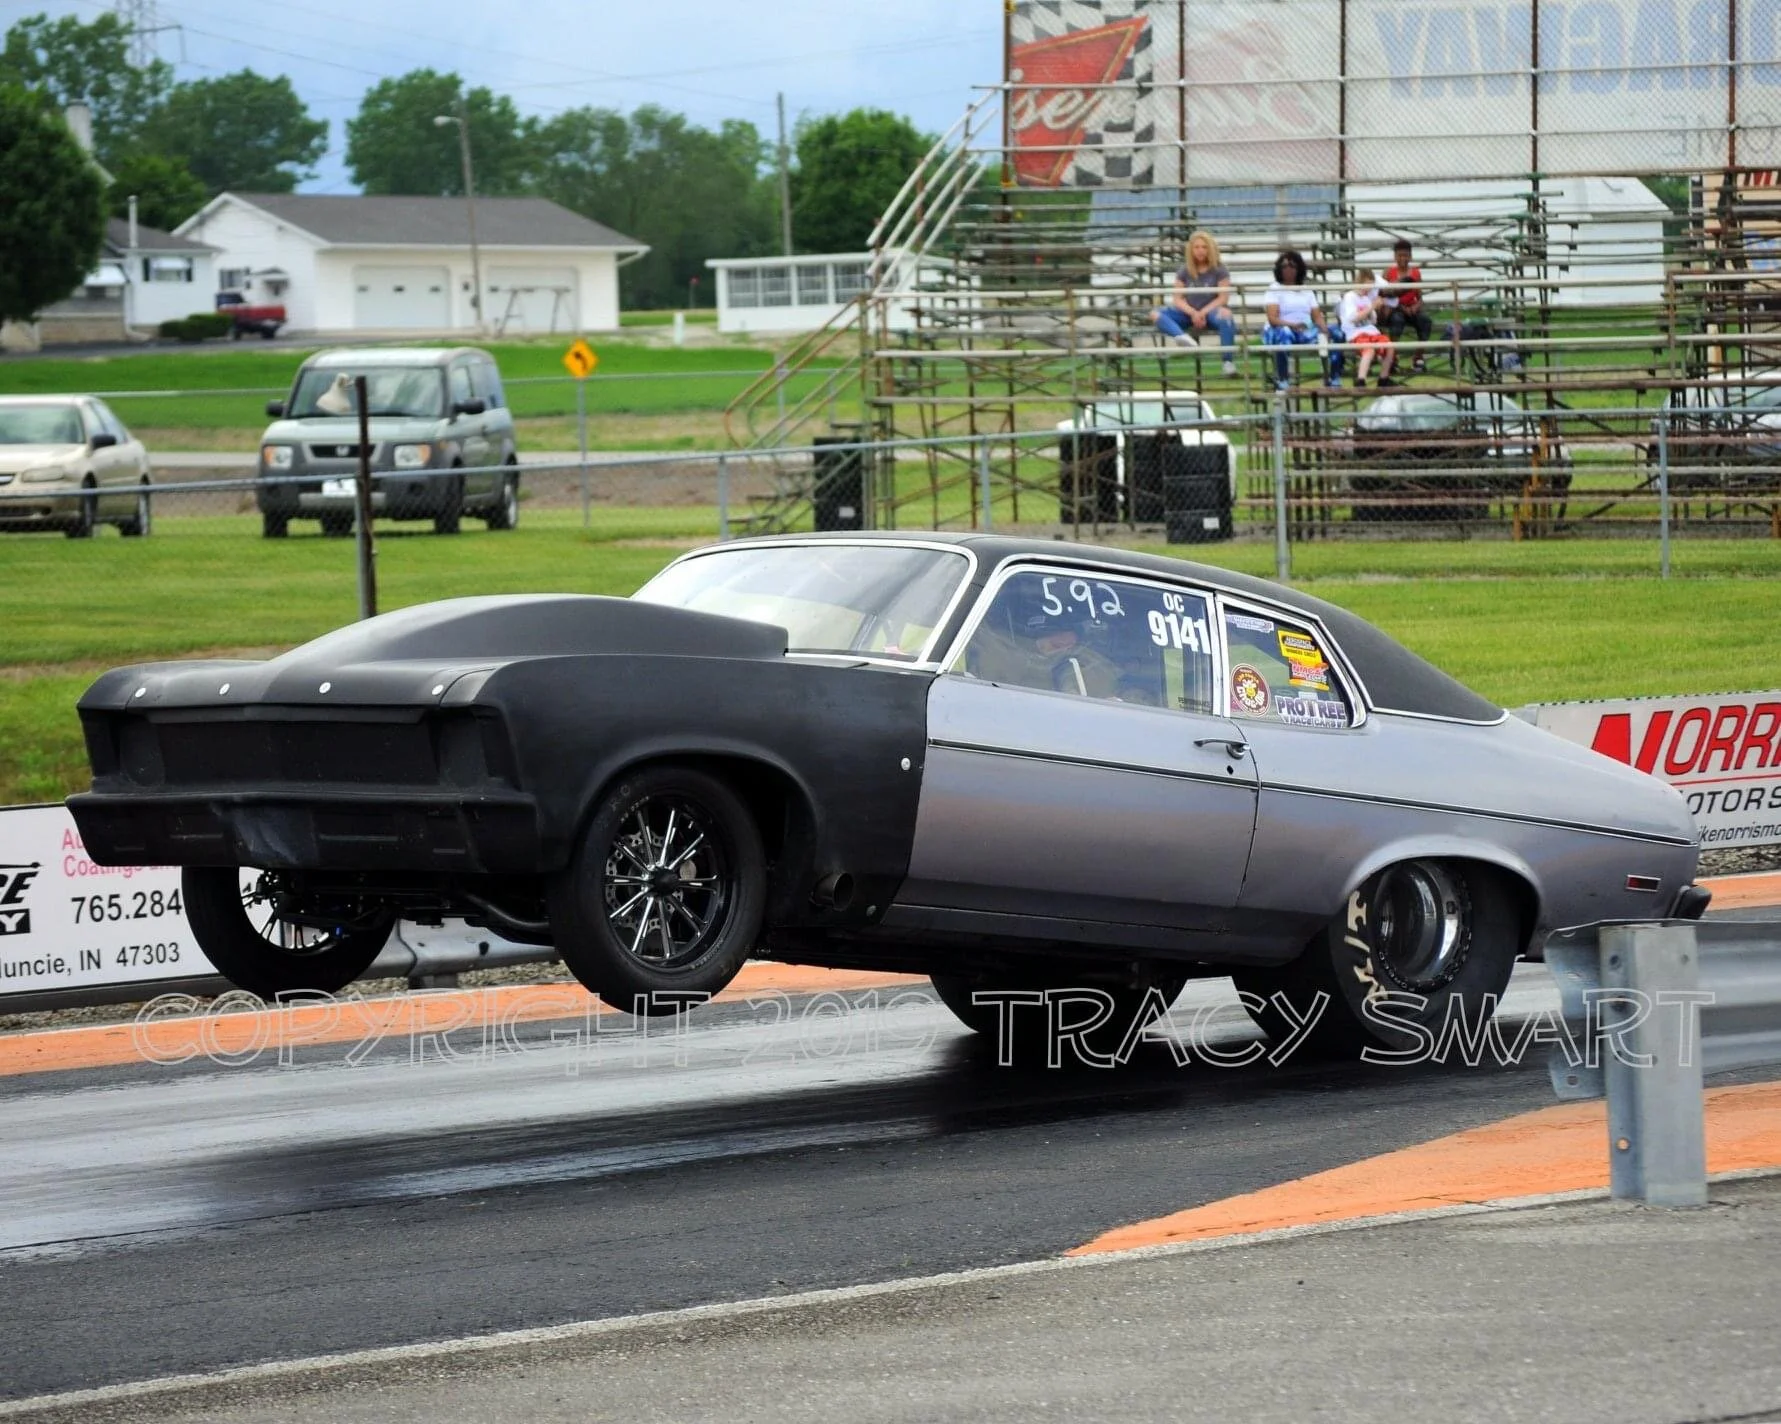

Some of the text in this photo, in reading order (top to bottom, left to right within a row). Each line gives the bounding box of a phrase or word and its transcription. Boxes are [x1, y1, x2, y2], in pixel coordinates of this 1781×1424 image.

[1042, 577, 1126, 619] 5.92
[1162, 591, 1185, 613] OC
[1147, 610, 1212, 655] 9141
[1681, 786, 1781, 815] OTORS
[71, 888, 182, 924] 765.284
[0, 942, 180, 979] uncie, IN 47303
